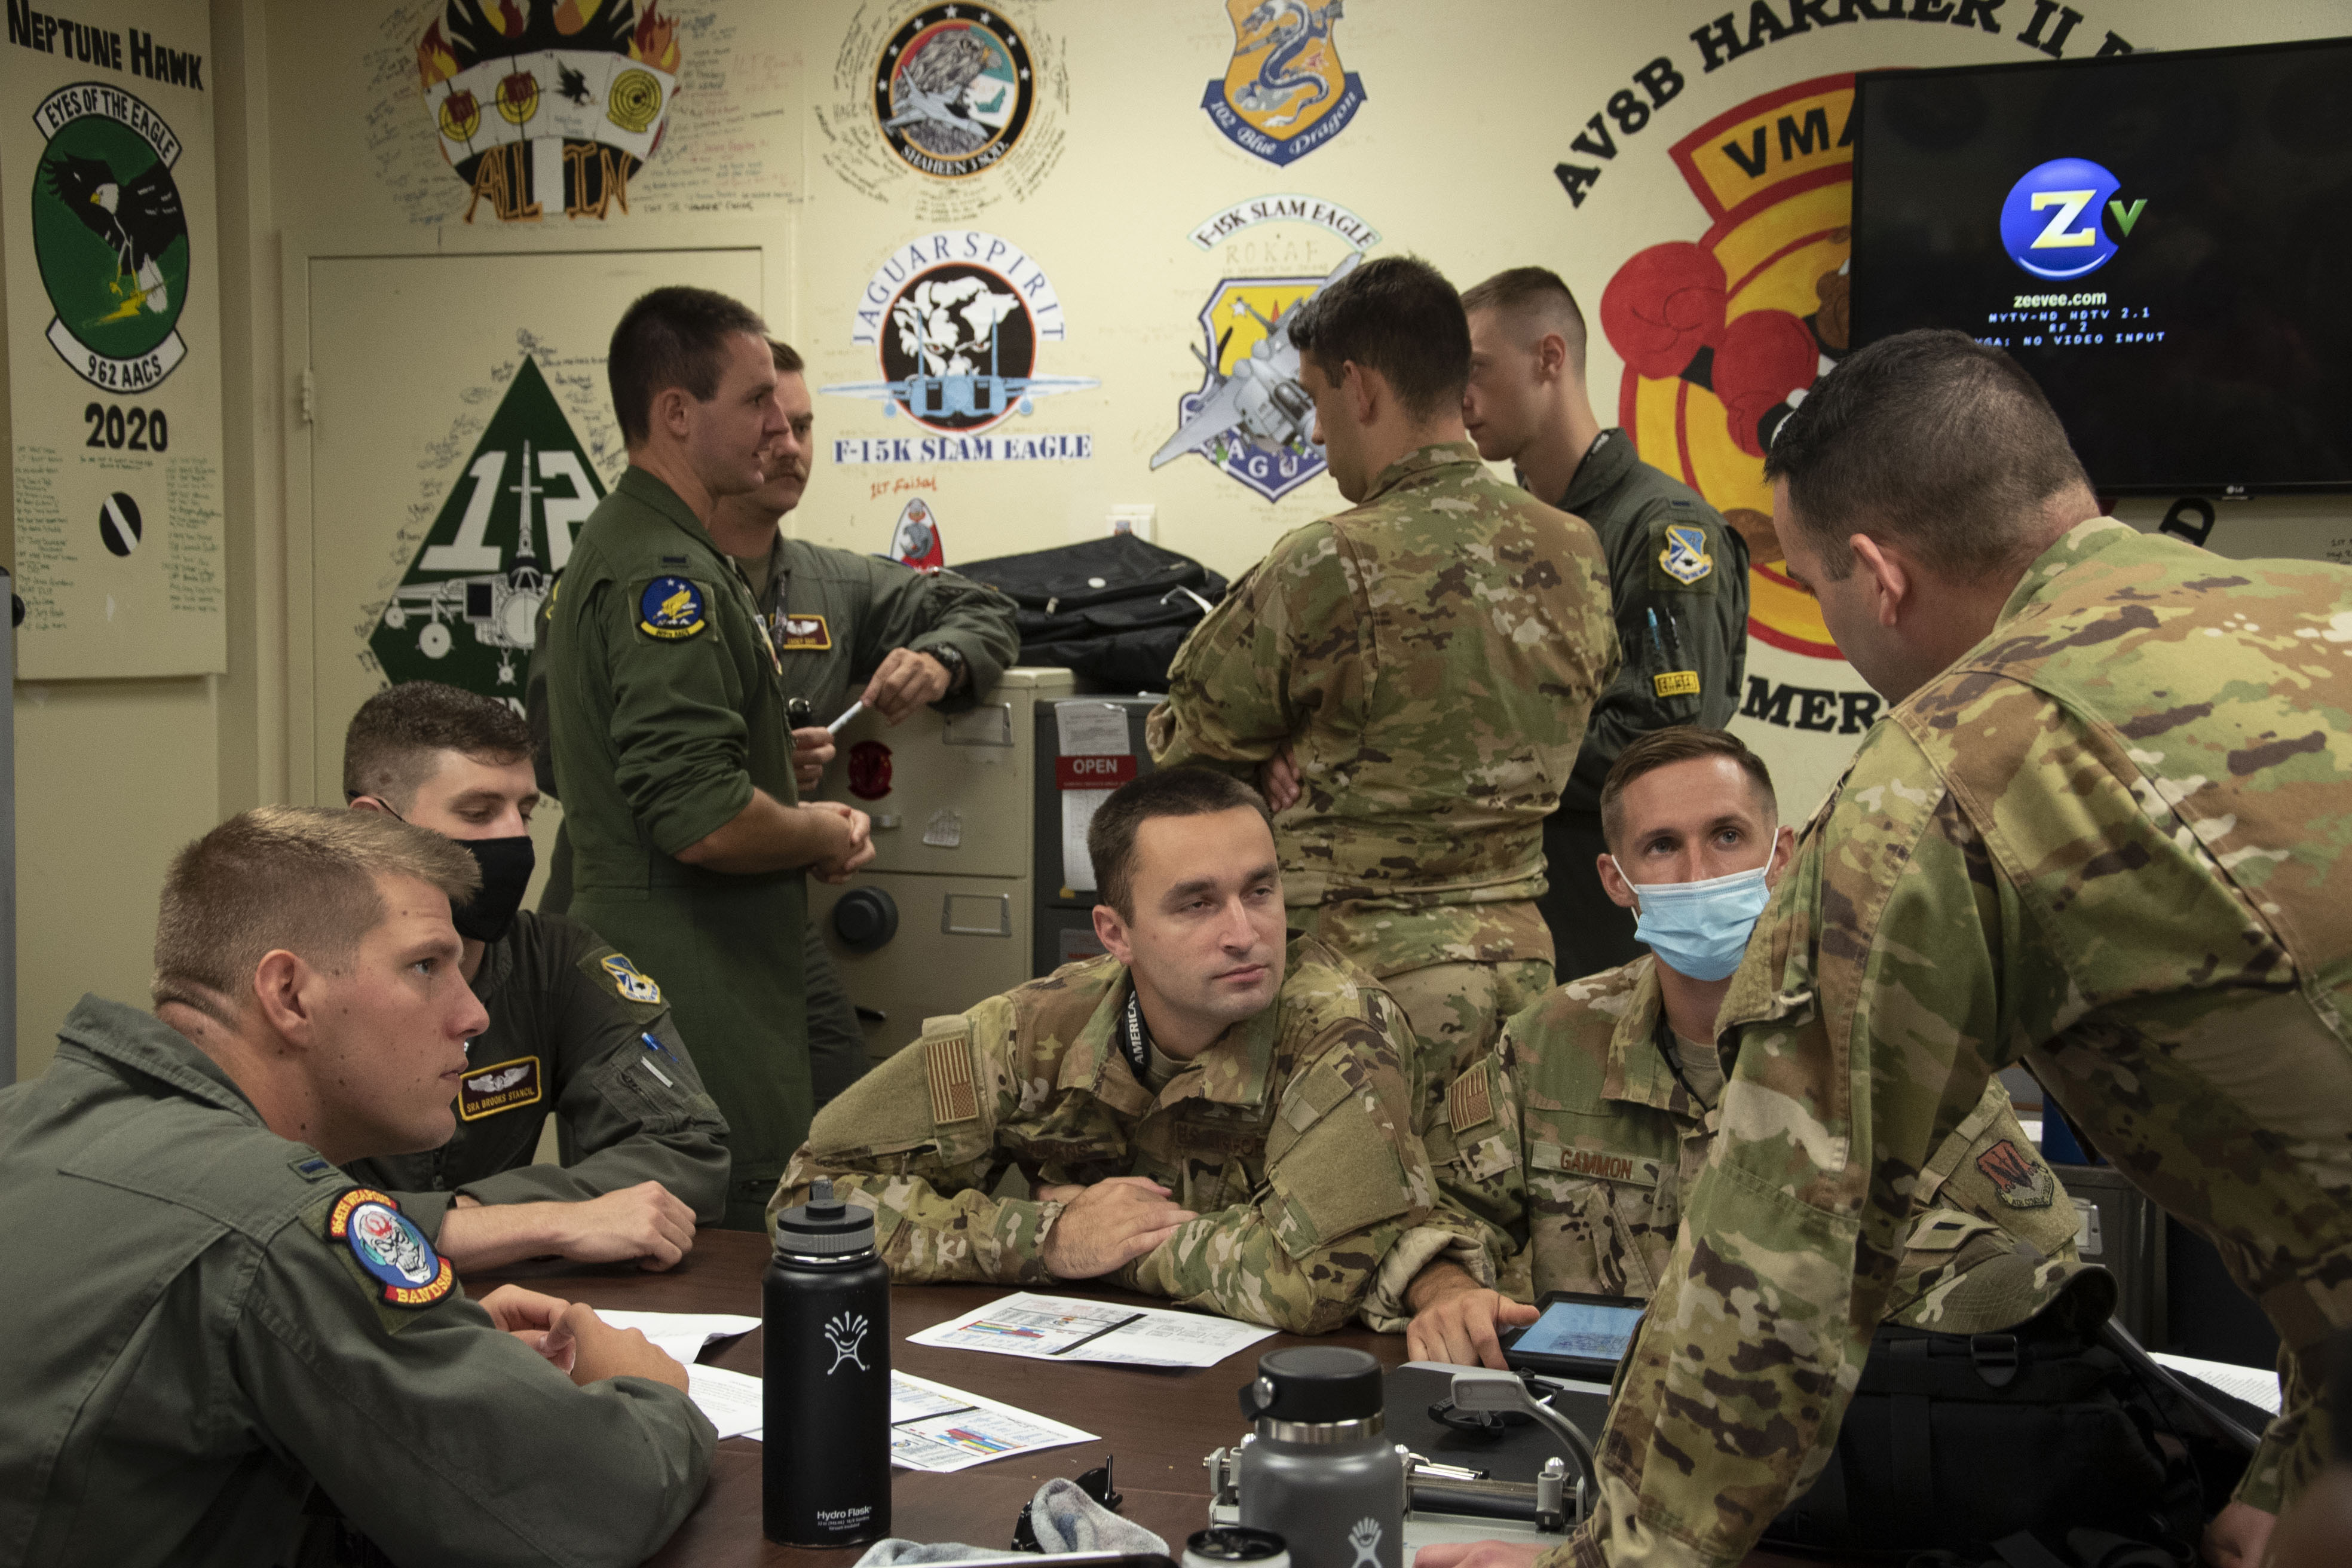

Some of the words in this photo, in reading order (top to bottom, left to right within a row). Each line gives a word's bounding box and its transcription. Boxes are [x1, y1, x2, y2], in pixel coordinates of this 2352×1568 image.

[45, 92, 82, 129] EYES
[82, 88, 98, 112] OF
[101, 90, 128, 121] THE
[131, 111, 174, 160] EAGLE
[1237, 126, 1278, 156] Blue
[1288, 91, 1356, 156] Dragon
[1553, 56, 1685, 209] AV8B
[1196, 209, 1247, 249] F-15K
[1251, 200, 1306, 219] SLAM
[1312, 204, 1373, 247] EAGLE
[2013, 292, 2107, 308] zeevee.com
[2121, 307, 2149, 319] 2.1
[2023, 335, 2042, 346] NO
[2053, 333, 2104, 345] VIDEO
[2115, 331, 2166, 344] INPUT
[2080, 321, 2087, 332] 2
[87, 354, 117, 385] 962
[121, 354, 162, 388] AACS
[85, 402, 168, 452] 2020
[835, 439, 913, 464] F-15K
[920, 437, 993, 462] SLAM
[1003, 434, 1092, 460] EAGLE
[1073, 758, 1118, 774] OPEN
[1561, 1149, 1633, 1180] GAMMON
[396, 1261, 453, 1304] BANDSAW
[817, 1510, 847, 1522] Hydro
